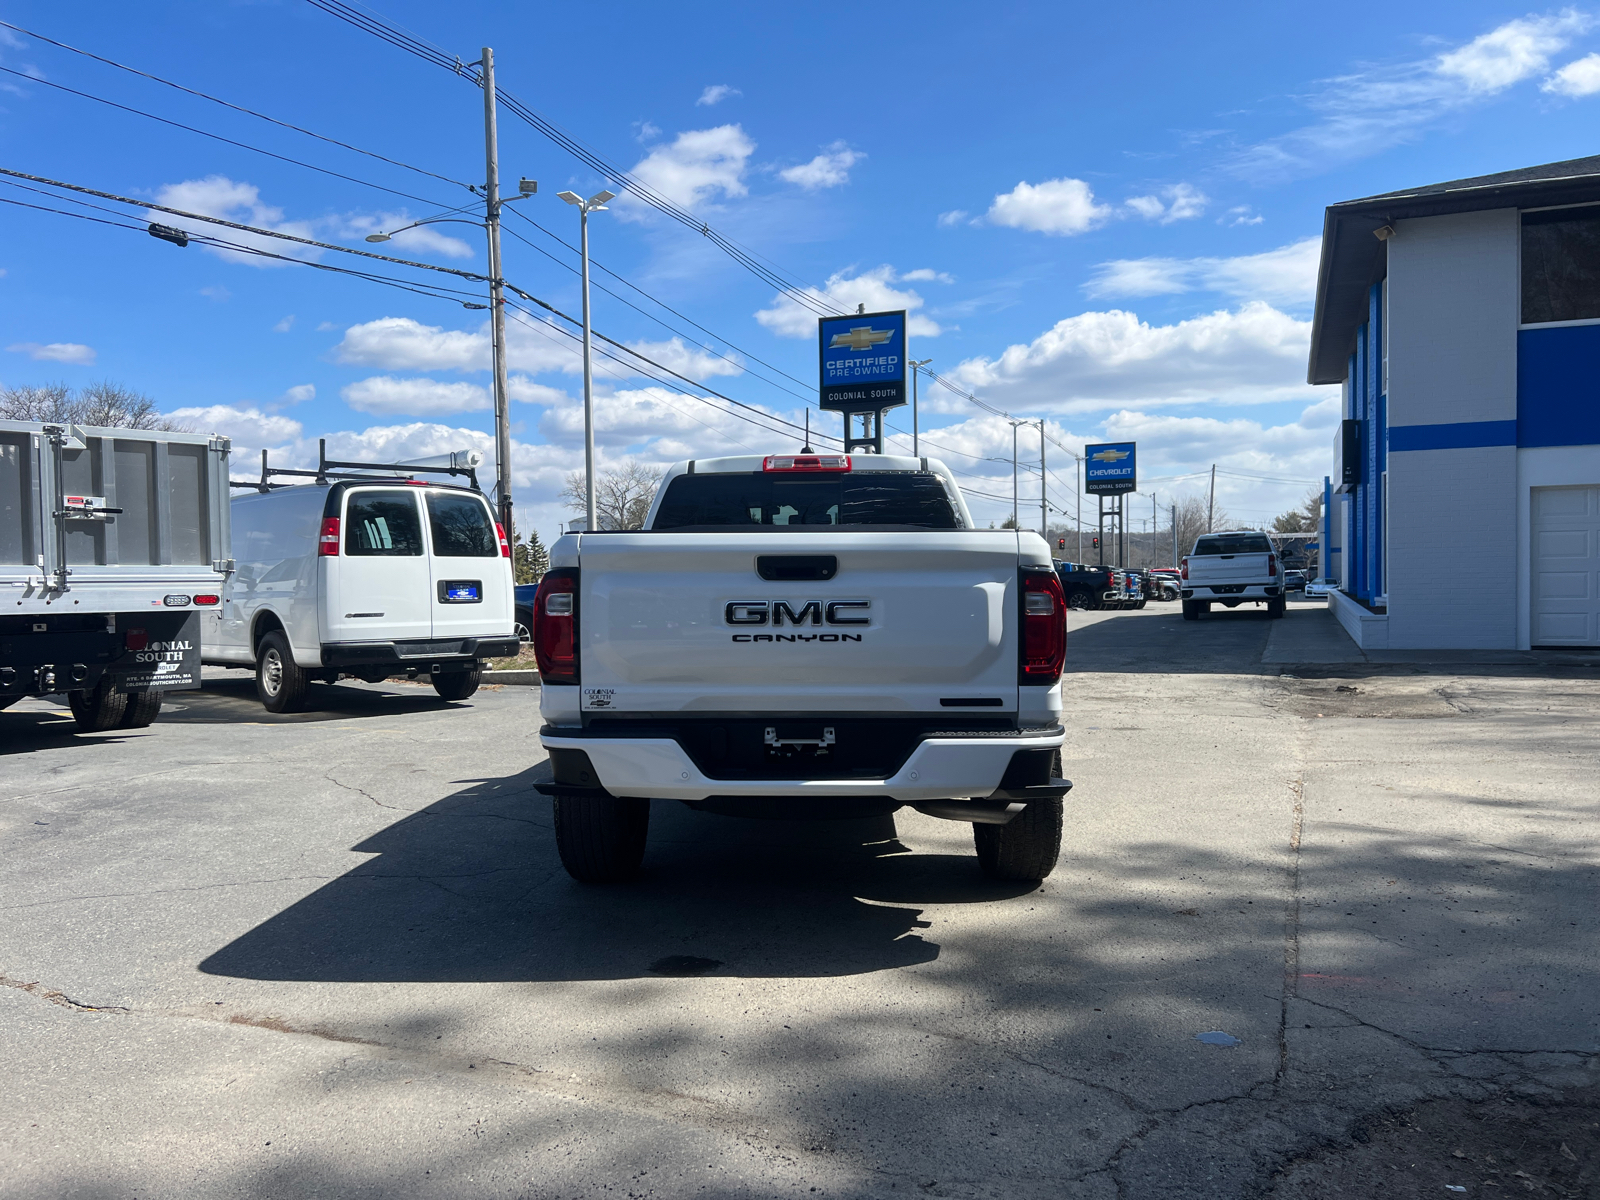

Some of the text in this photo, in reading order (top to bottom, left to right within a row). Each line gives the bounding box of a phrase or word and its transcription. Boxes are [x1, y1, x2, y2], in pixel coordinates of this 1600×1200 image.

[826, 355, 898, 369] CERTIFIED
[829, 365, 894, 378] PRE-OWNED
[828, 389, 896, 401] COLONIAL SOUTH
[1090, 468, 1132, 476] CHEVROLET
[724, 599, 872, 627] GMC
[732, 633, 862, 643] CANYON
[135, 651, 184, 662] SOUTH
